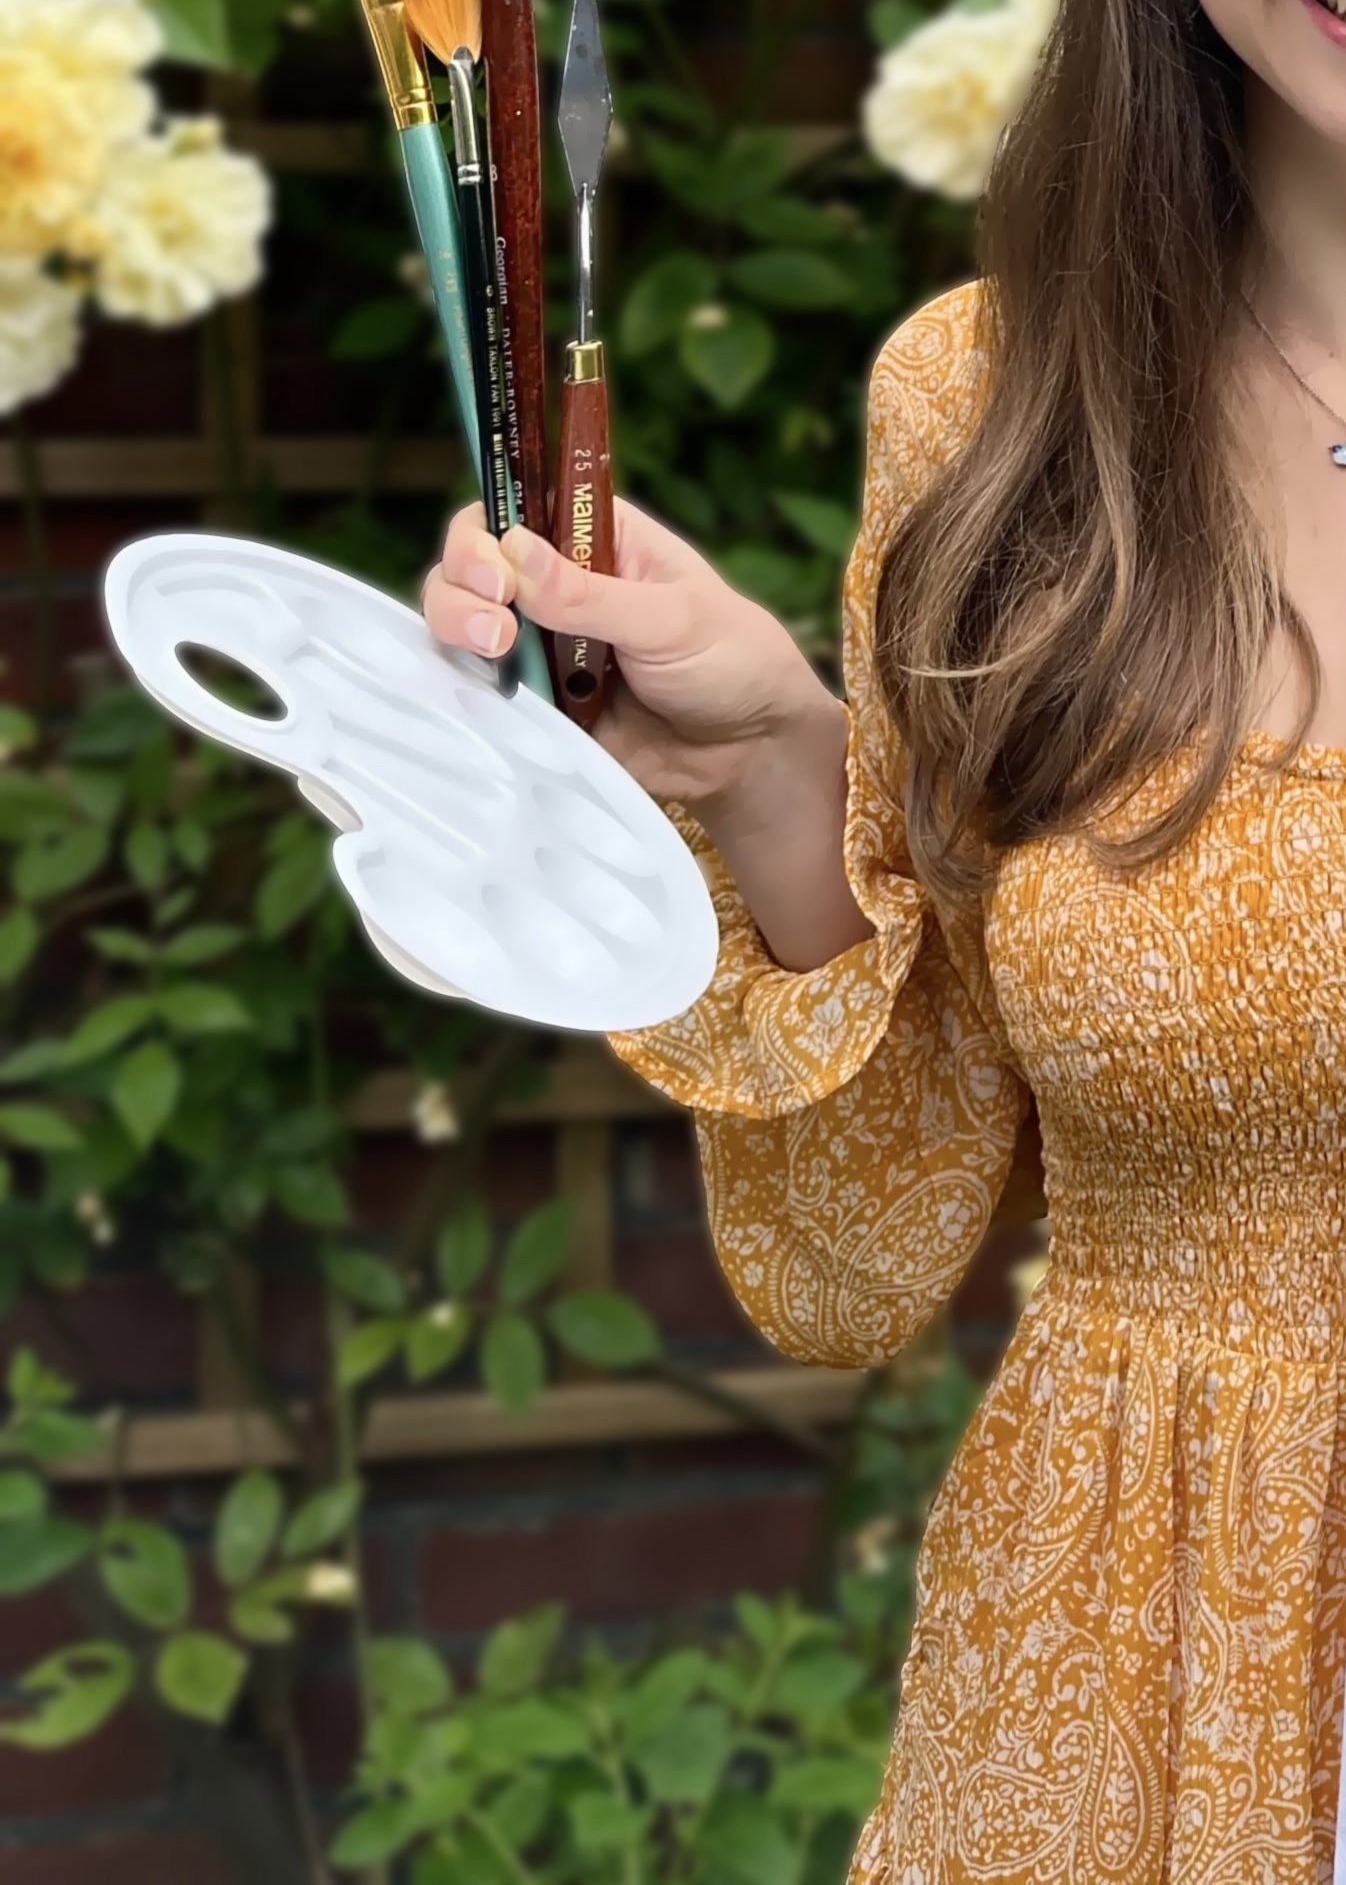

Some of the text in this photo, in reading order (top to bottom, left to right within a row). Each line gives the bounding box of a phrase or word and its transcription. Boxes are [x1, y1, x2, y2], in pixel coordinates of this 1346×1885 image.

[486, 307, 497, 341] BROWN
[496, 236, 508, 304] Georgian
[502, 327, 520, 458] DALER-ROWNEY
[491, 385, 501, 403] FAN
[574, 638, 587, 668] ITALY
